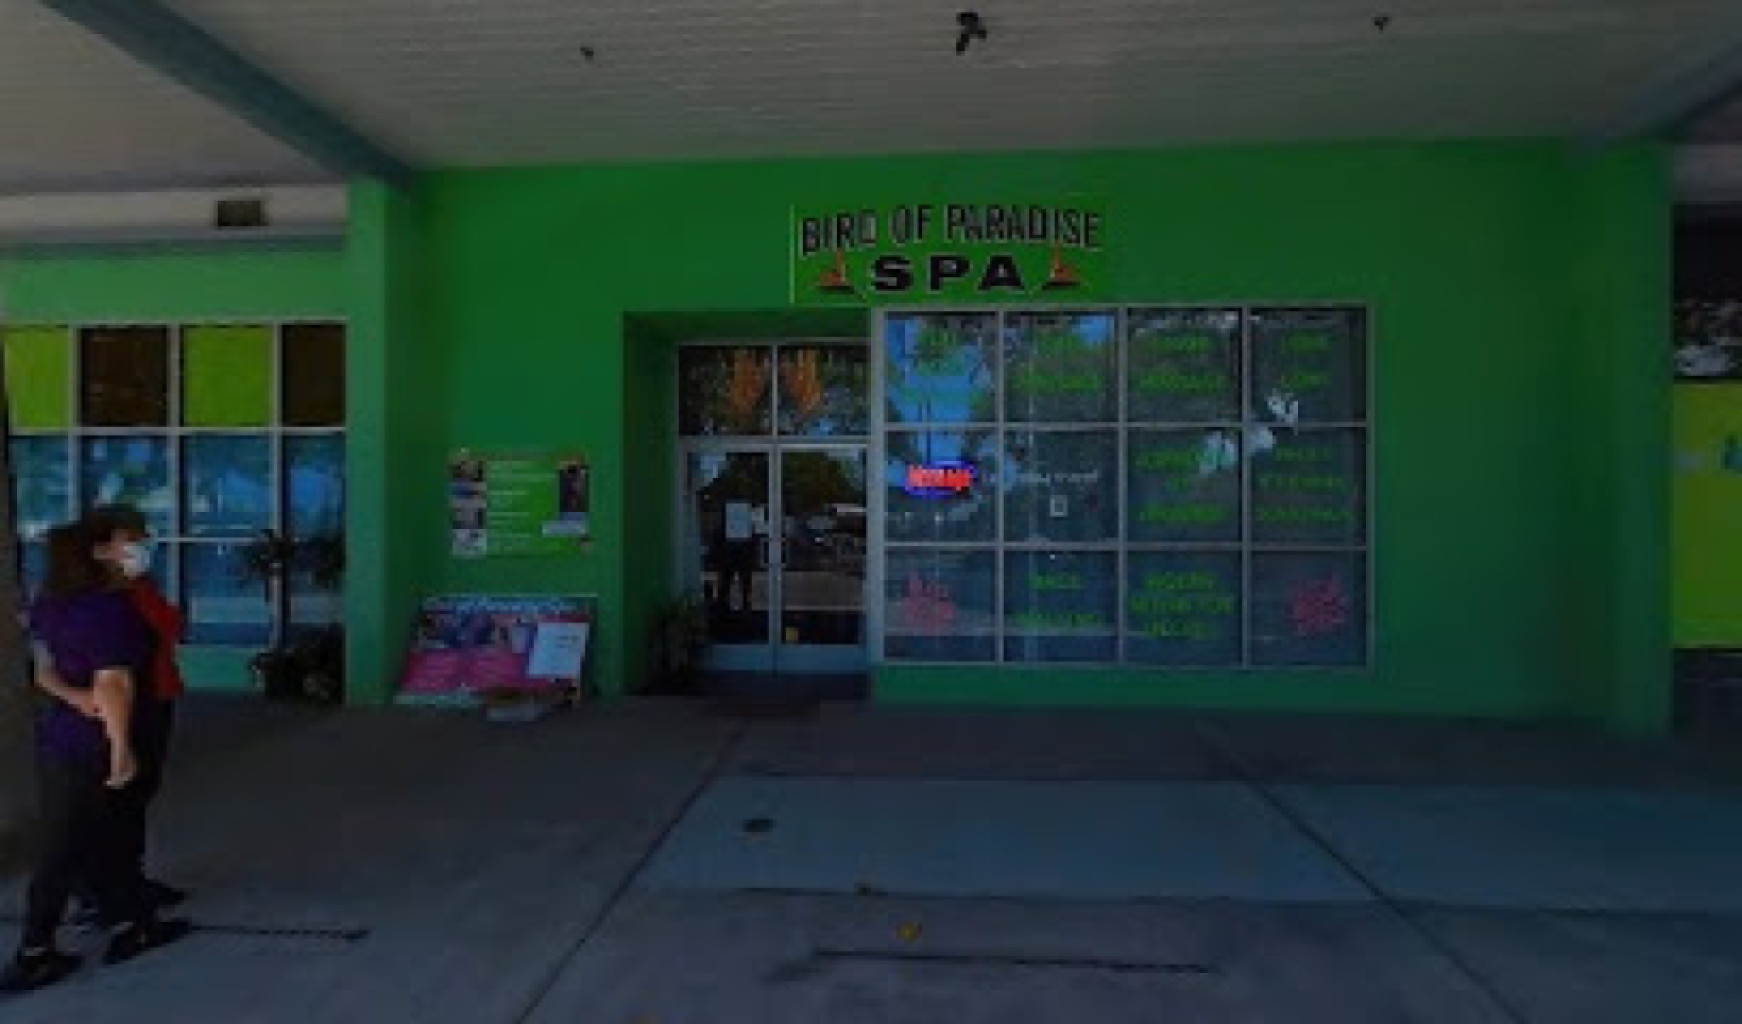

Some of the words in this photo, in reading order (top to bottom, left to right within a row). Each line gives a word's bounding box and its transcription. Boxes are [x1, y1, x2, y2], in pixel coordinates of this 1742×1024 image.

[799, 208, 877, 258] BIRD
[889, 204, 935, 246] OF
[944, 204, 1103, 249] PARADISE
[873, 255, 1024, 293] SPA
